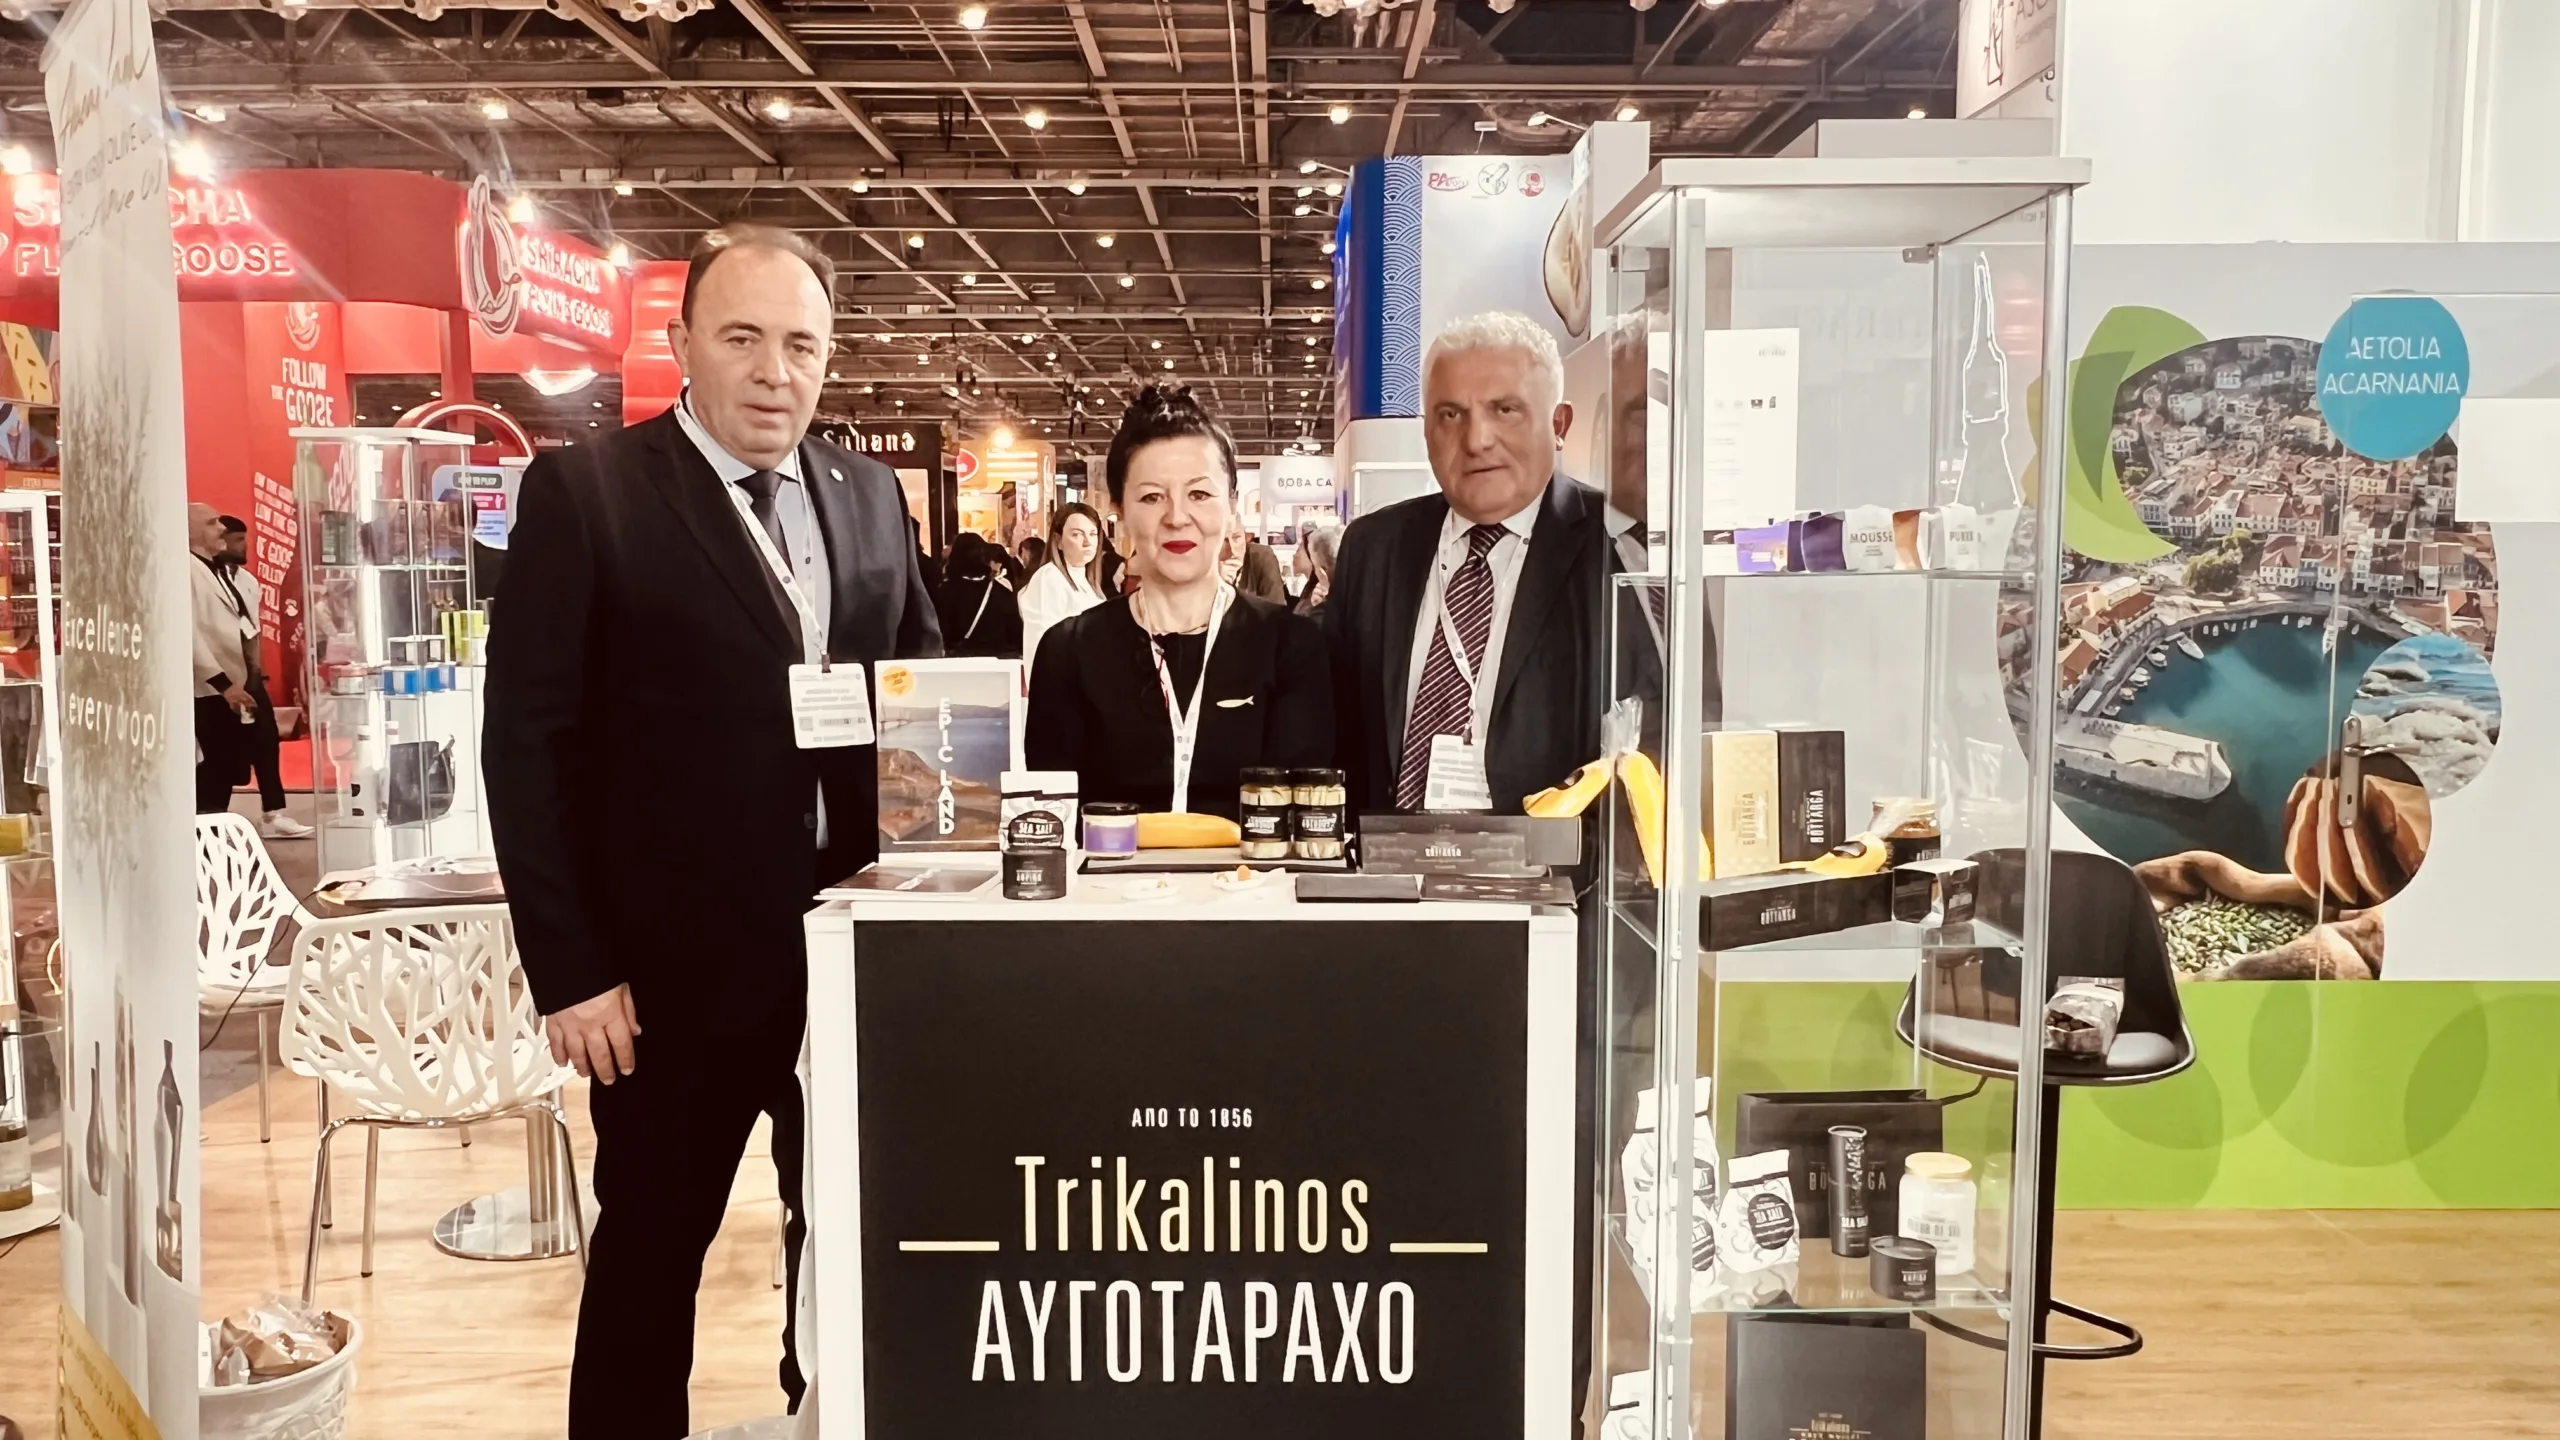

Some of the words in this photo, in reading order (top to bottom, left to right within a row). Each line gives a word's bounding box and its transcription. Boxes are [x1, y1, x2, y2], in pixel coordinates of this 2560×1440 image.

[2345, 336, 2441, 360] AETOLIA
[282, 357, 326, 390] FOLLOW
[2322, 372, 2460, 395] ACARNANIA
[1278, 477, 1312, 489] BOBA
[1850, 531, 1893, 544] MOUSSE
[68, 692, 113, 746] every
[937, 697, 954, 763] EPIC
[937, 769, 955, 835] LAND
[1808, 789, 1825, 844] BOTTARGA
[1131, 1108, 1168, 1128] ΑΠΟ
[1178, 1108, 1199, 1128] ΤΟ
[1210, 1108, 1253, 1128] 1856
[1015, 1156, 1369, 1253] Trikalinos
[971, 1280, 1415, 1383] ΑΥΓΟΤΑΡΑΧΟ
